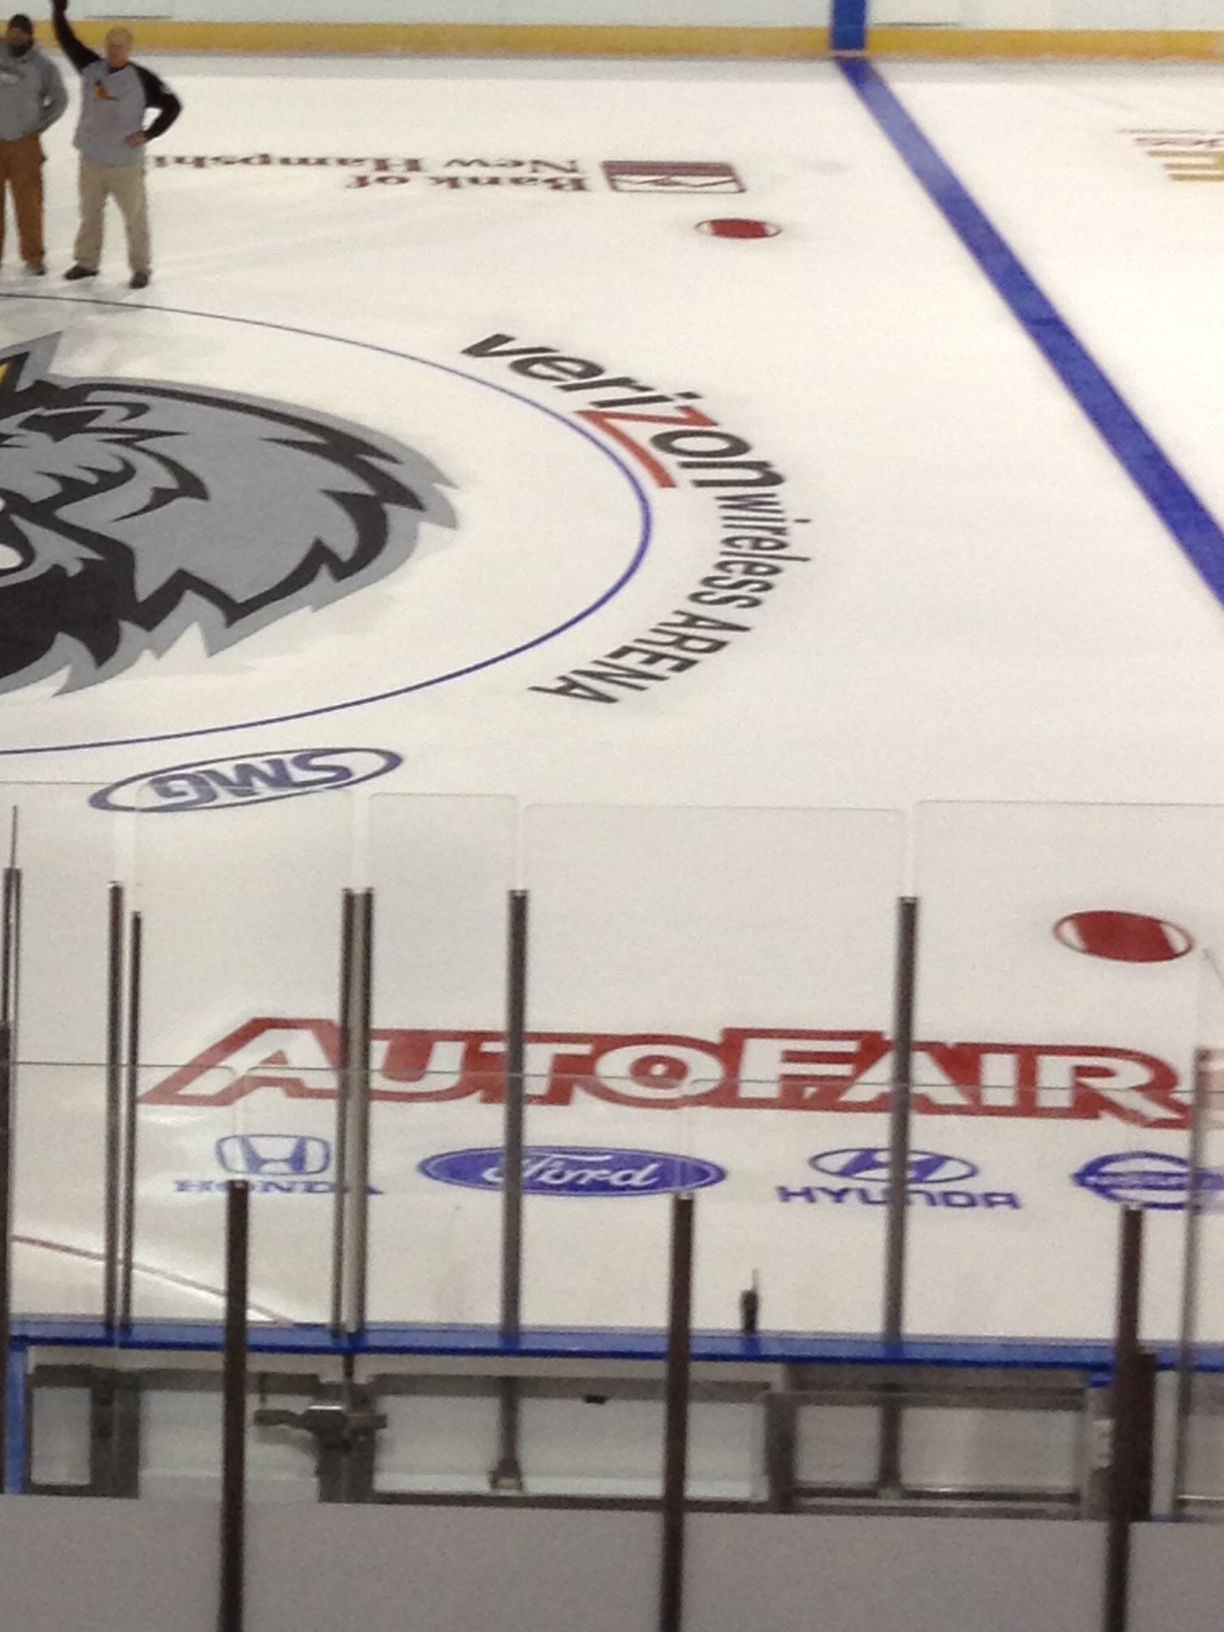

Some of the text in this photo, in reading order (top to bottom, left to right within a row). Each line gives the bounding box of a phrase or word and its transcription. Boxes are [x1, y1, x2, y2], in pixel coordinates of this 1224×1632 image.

[152, 154, 577, 174] New Hampshi
[345, 175, 589, 192] Bank of
[460, 333, 812, 705] verizon wireless ARENA
[149, 750, 354, 811] SMG
[481, 1152, 661, 1187] Ford
[174, 1179, 384, 1195] HOND
